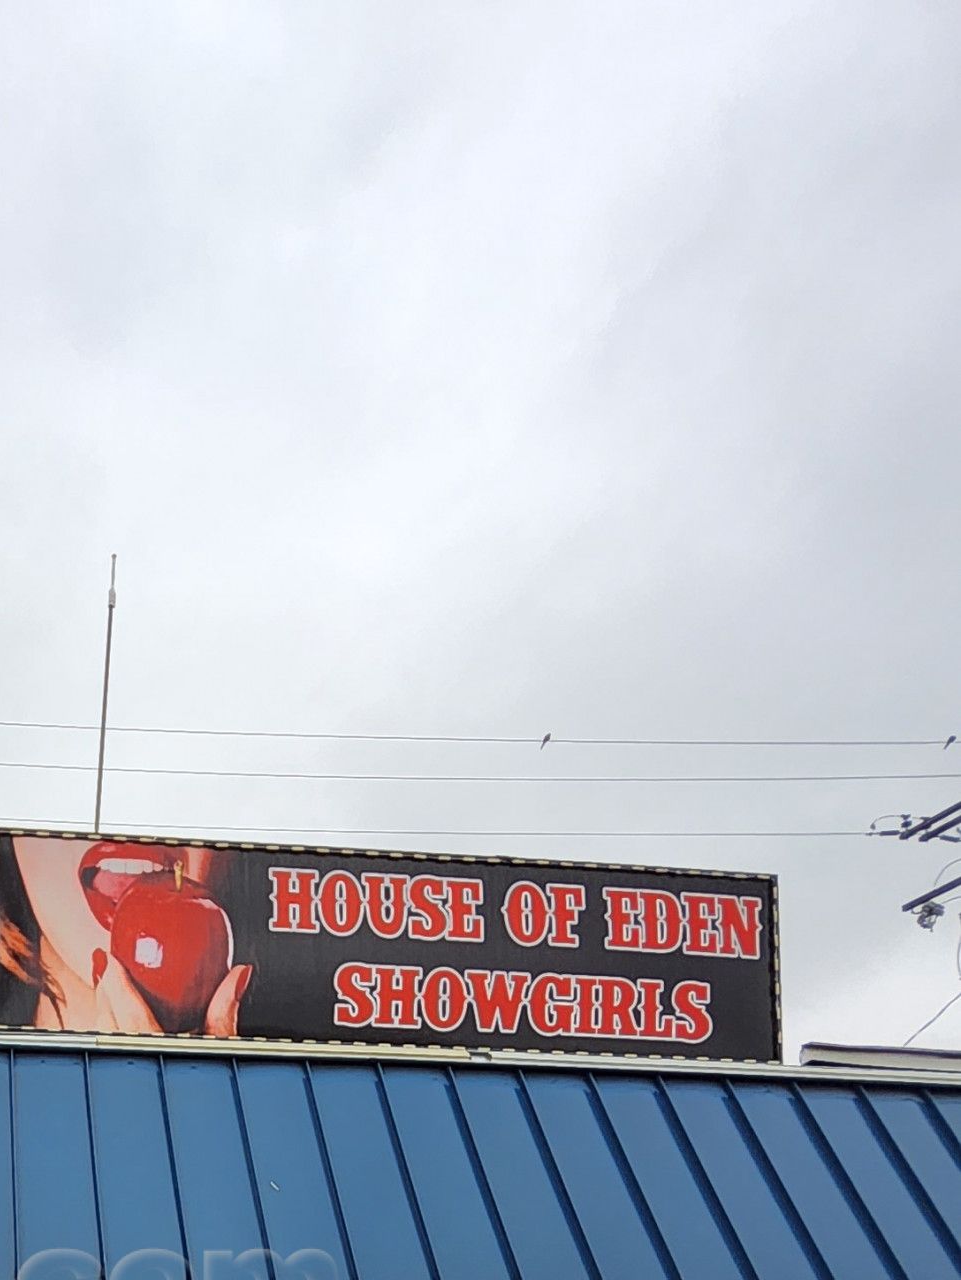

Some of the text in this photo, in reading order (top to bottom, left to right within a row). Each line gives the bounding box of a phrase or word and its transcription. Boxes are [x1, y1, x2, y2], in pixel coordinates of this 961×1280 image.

[268, 866, 762, 959] HOUSE OF EDEN
[333, 962, 712, 1043] SHOWGIRLS
